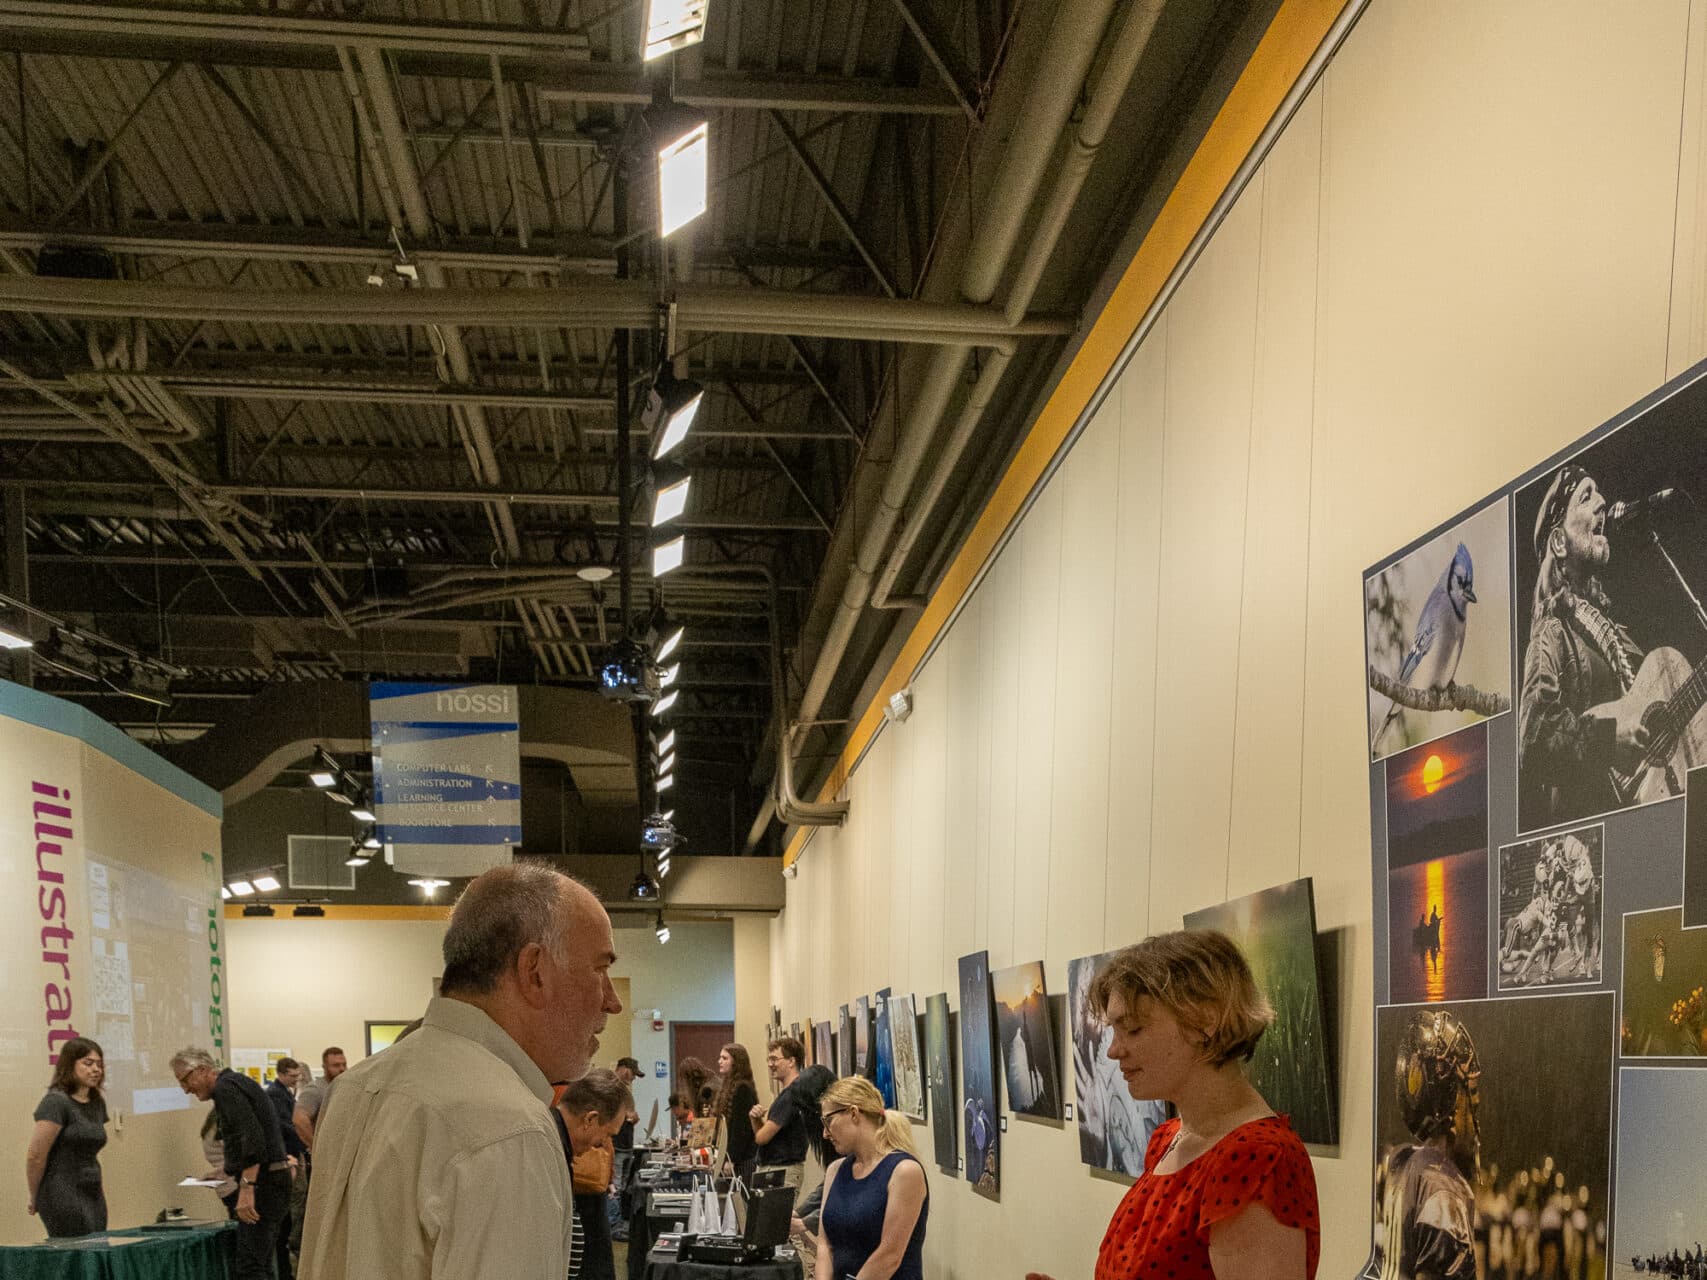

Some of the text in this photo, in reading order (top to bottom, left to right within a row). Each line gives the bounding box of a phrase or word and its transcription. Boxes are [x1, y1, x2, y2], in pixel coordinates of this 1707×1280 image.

[396, 763, 446, 773] COMPUTER
[398, 778, 472, 788] ADMINISTRATION
[398, 793, 443, 802] LEARNING
[448, 803, 483, 813] CENTER
[32, 780, 81, 1066] illustrat
